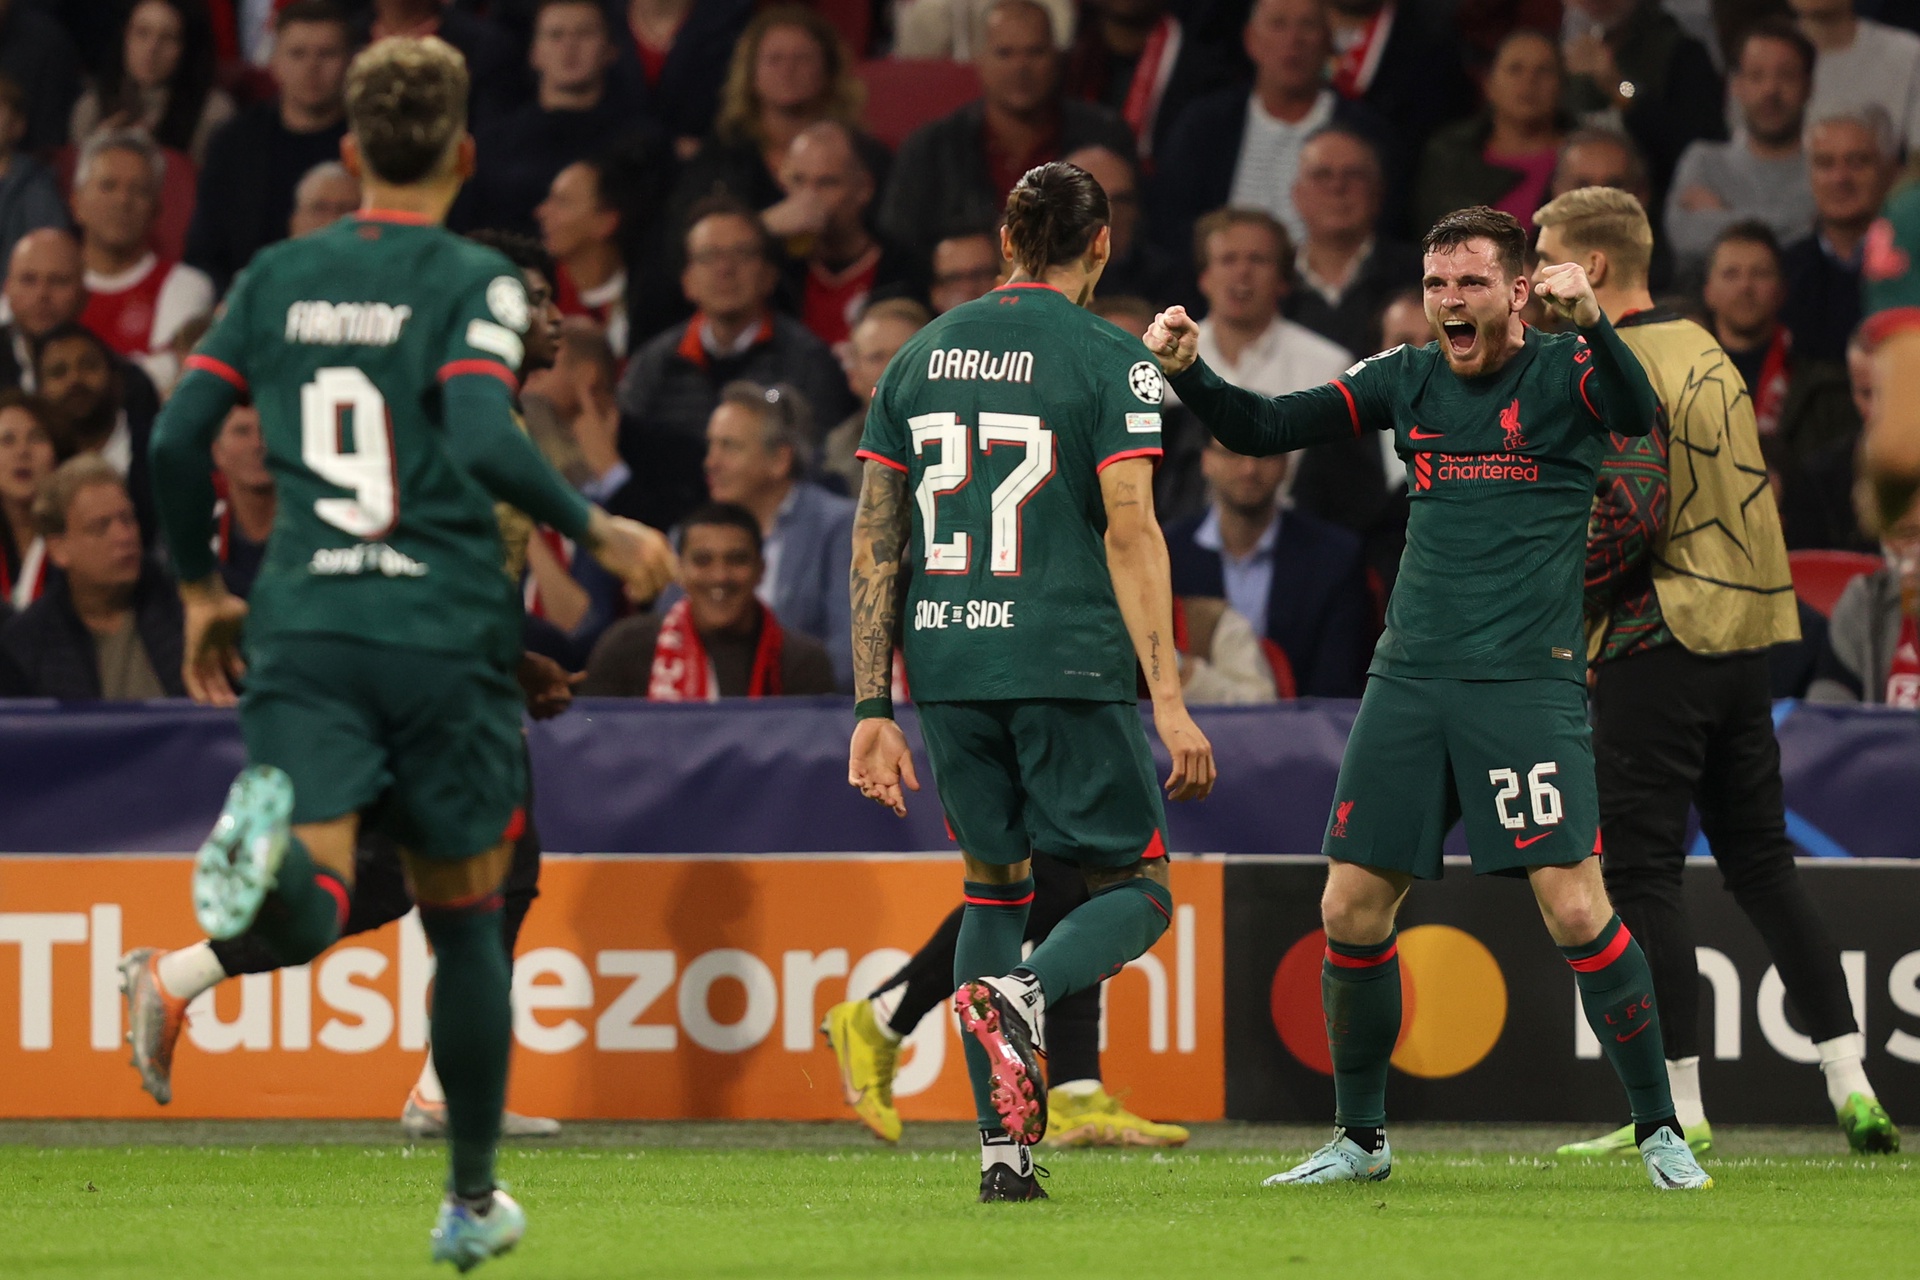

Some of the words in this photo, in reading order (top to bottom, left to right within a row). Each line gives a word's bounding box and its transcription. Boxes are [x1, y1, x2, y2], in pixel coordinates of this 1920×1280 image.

[927, 348, 1034, 383] DARWIN
[300, 366, 399, 539] 9
[1503, 436, 1530, 450] LFC
[1438, 463, 1538, 481] chartered
[907, 412, 1057, 577] 27
[915, 600, 950, 631] SIDE
[966, 600, 1015, 629] SIDE
[1489, 762, 1564, 829] 26
